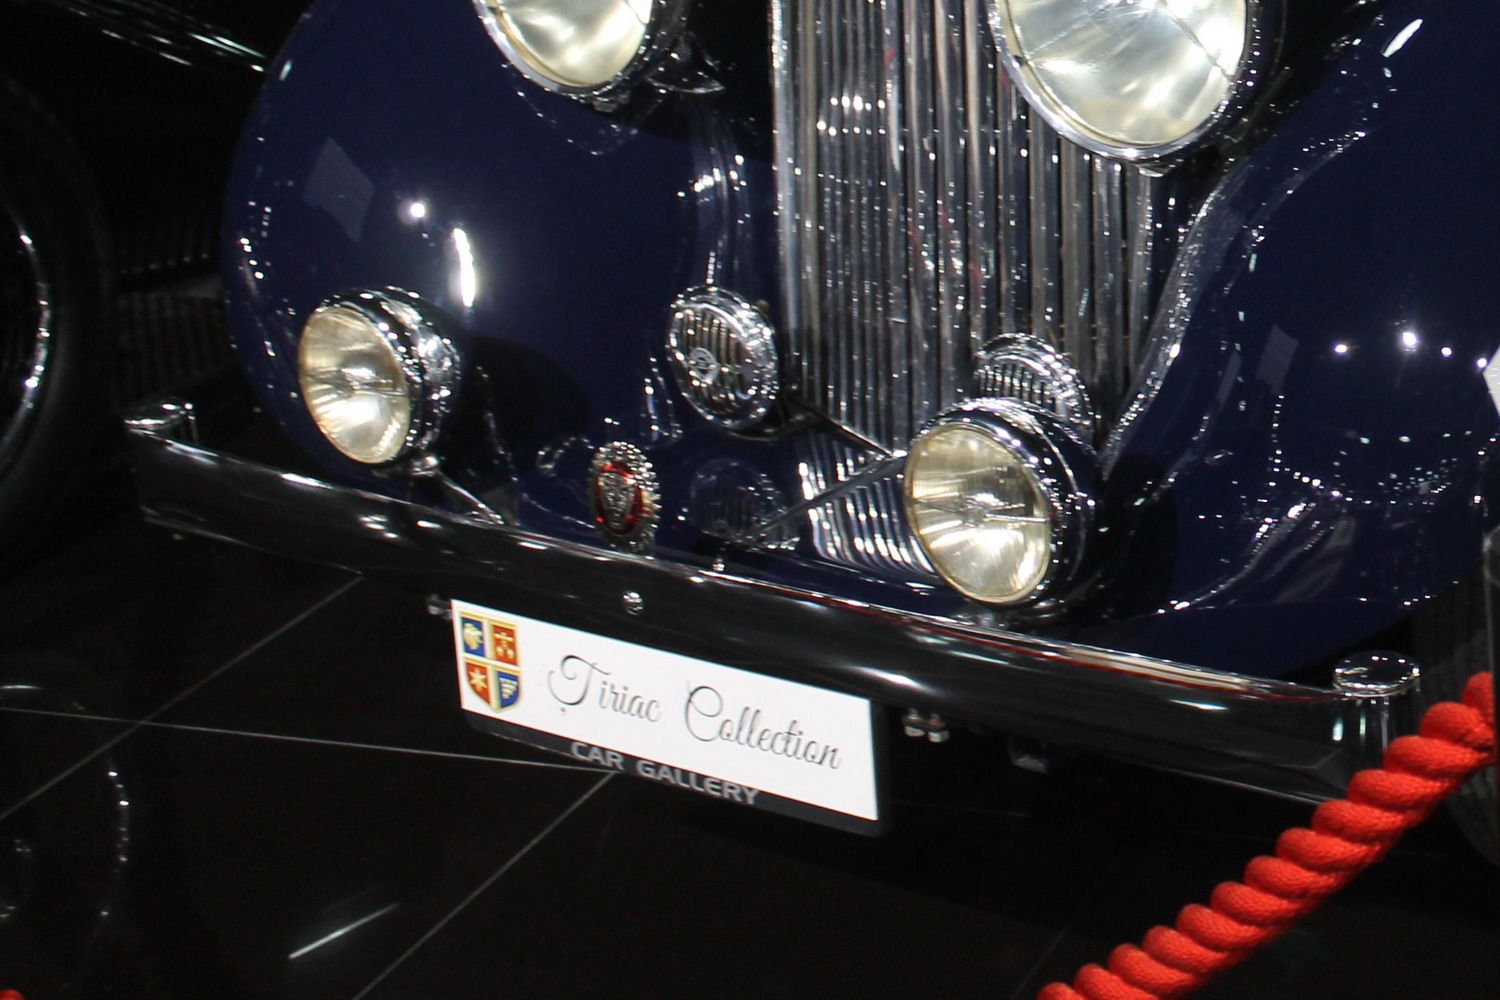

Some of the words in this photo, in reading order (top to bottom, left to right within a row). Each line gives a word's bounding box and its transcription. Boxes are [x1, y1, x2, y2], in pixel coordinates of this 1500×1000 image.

[684, 684, 844, 770] Collection
[571, 741, 625, 771] CAR
[635, 759, 762, 805] GALLERY
